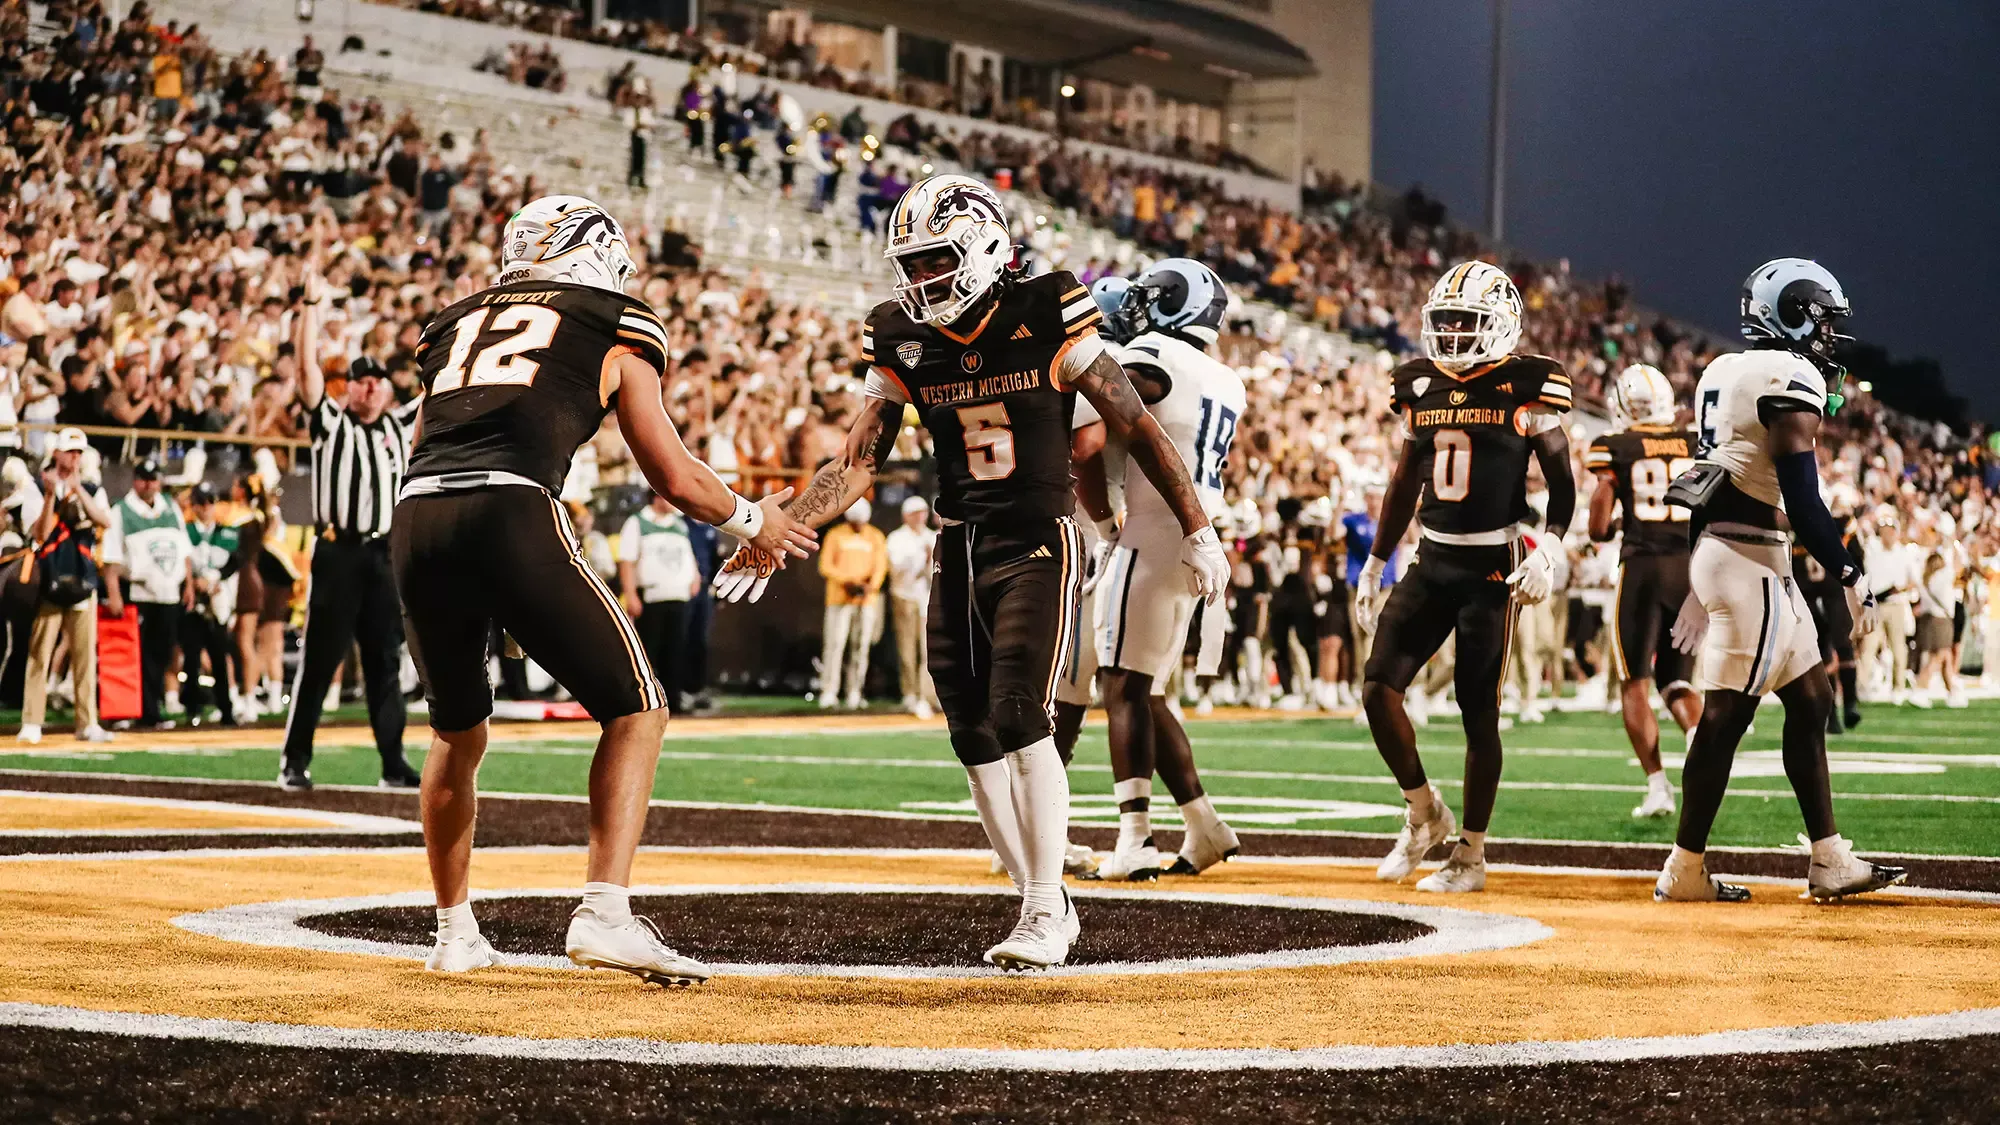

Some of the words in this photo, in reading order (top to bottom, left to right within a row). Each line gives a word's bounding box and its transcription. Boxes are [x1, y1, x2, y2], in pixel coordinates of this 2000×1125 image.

[515, 230, 525, 239] 12
[892, 235, 911, 246] GRIT
[430, 303, 562, 396] 12
[899, 349, 921, 360] MAC
[964, 354, 978, 369] W
[919, 380, 974, 405] WESTERN
[978, 368, 1040, 397] MICHIGAN
[1456, 408, 1506, 425] MICHIGAN
[955, 401, 1017, 481] 5
[1193, 395, 1237, 490] 19
[1433, 429, 1473, 502] 0
